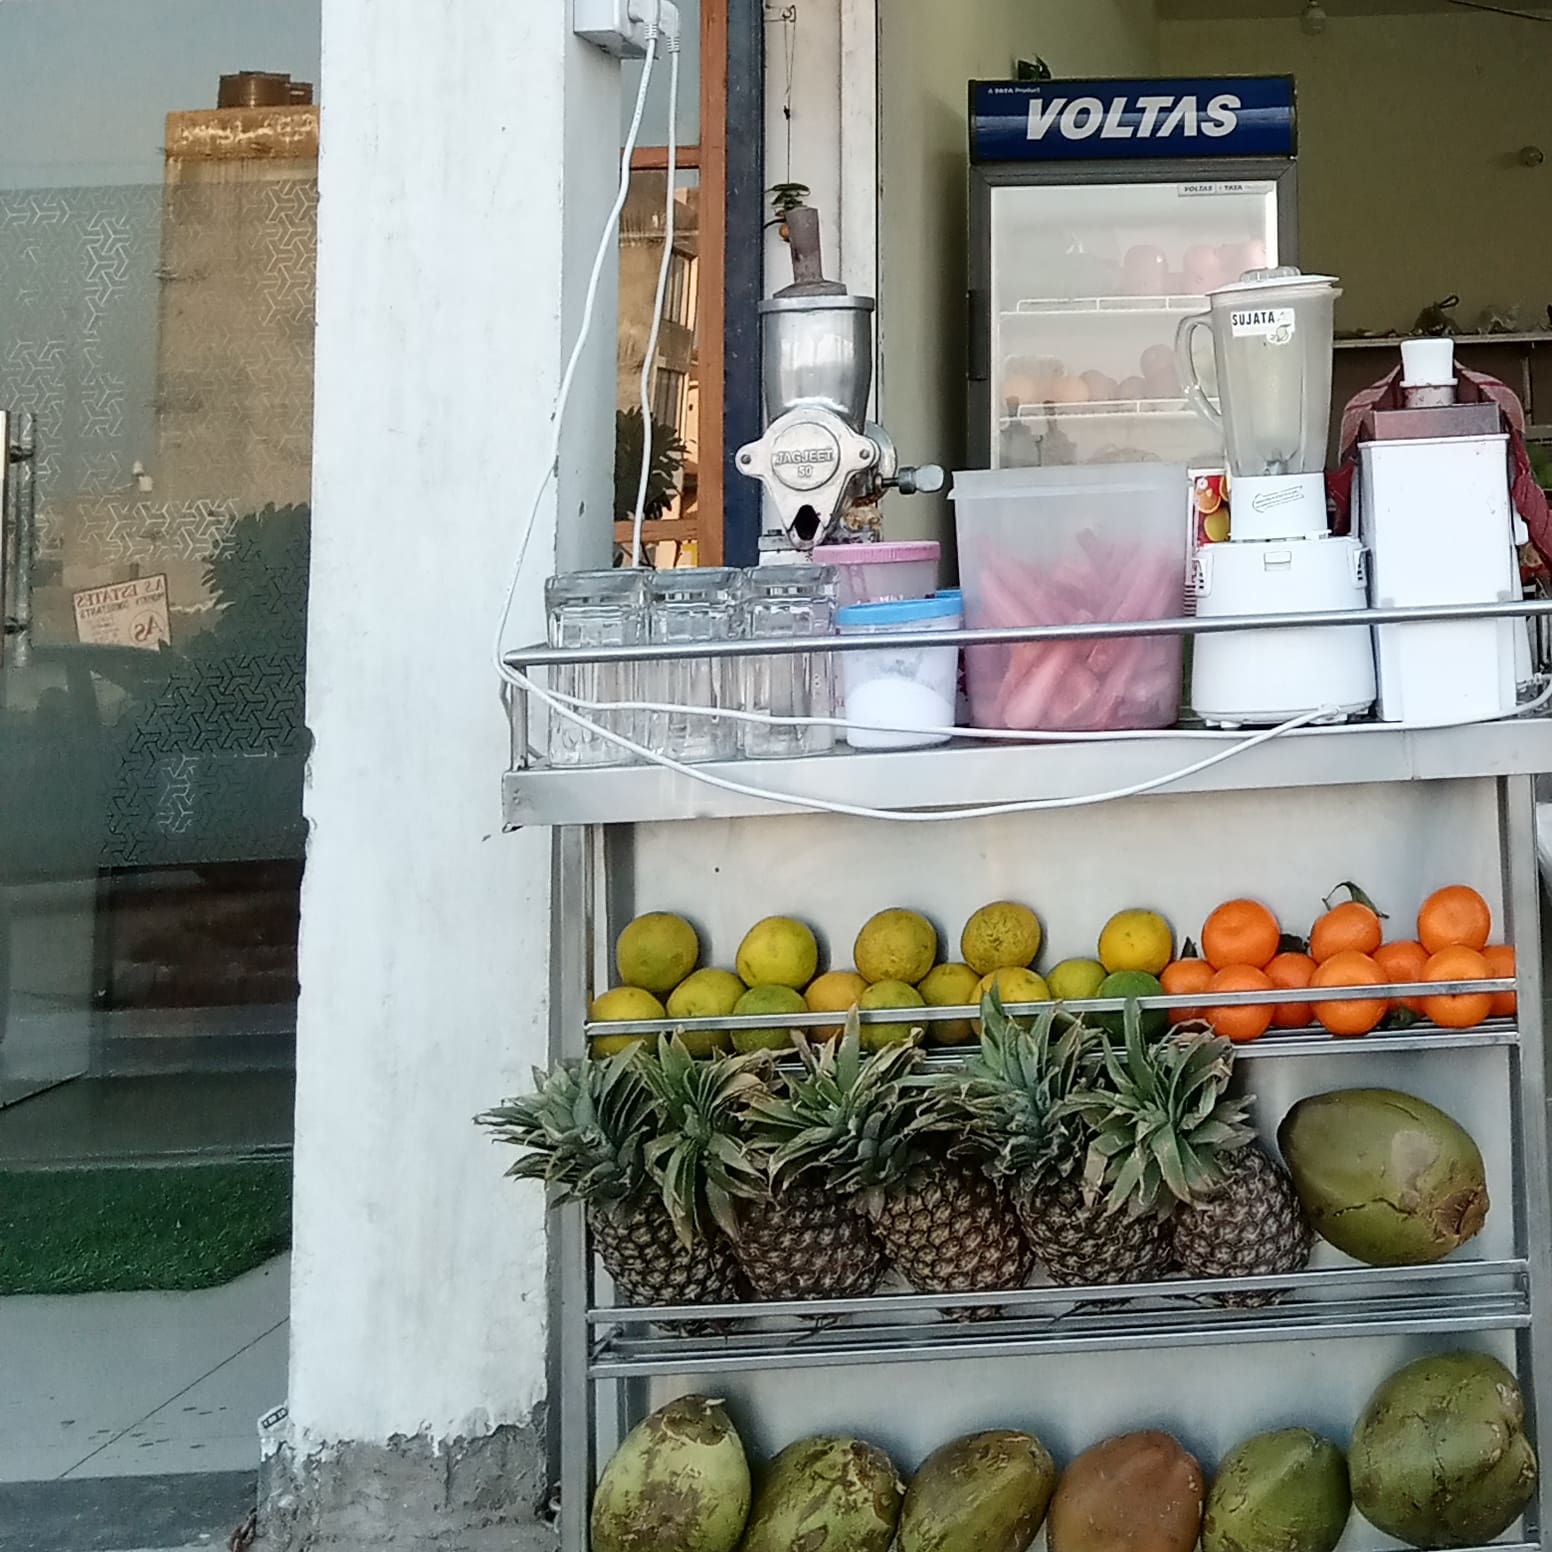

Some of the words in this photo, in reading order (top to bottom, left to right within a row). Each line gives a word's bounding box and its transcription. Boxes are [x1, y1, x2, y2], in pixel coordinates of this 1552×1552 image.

[1026, 94, 1242, 140] VOLTAS
[1232, 311, 1275, 326] SUJATA
[775, 448, 834, 466] JAGJEET
[797, 464, 814, 478] 50
